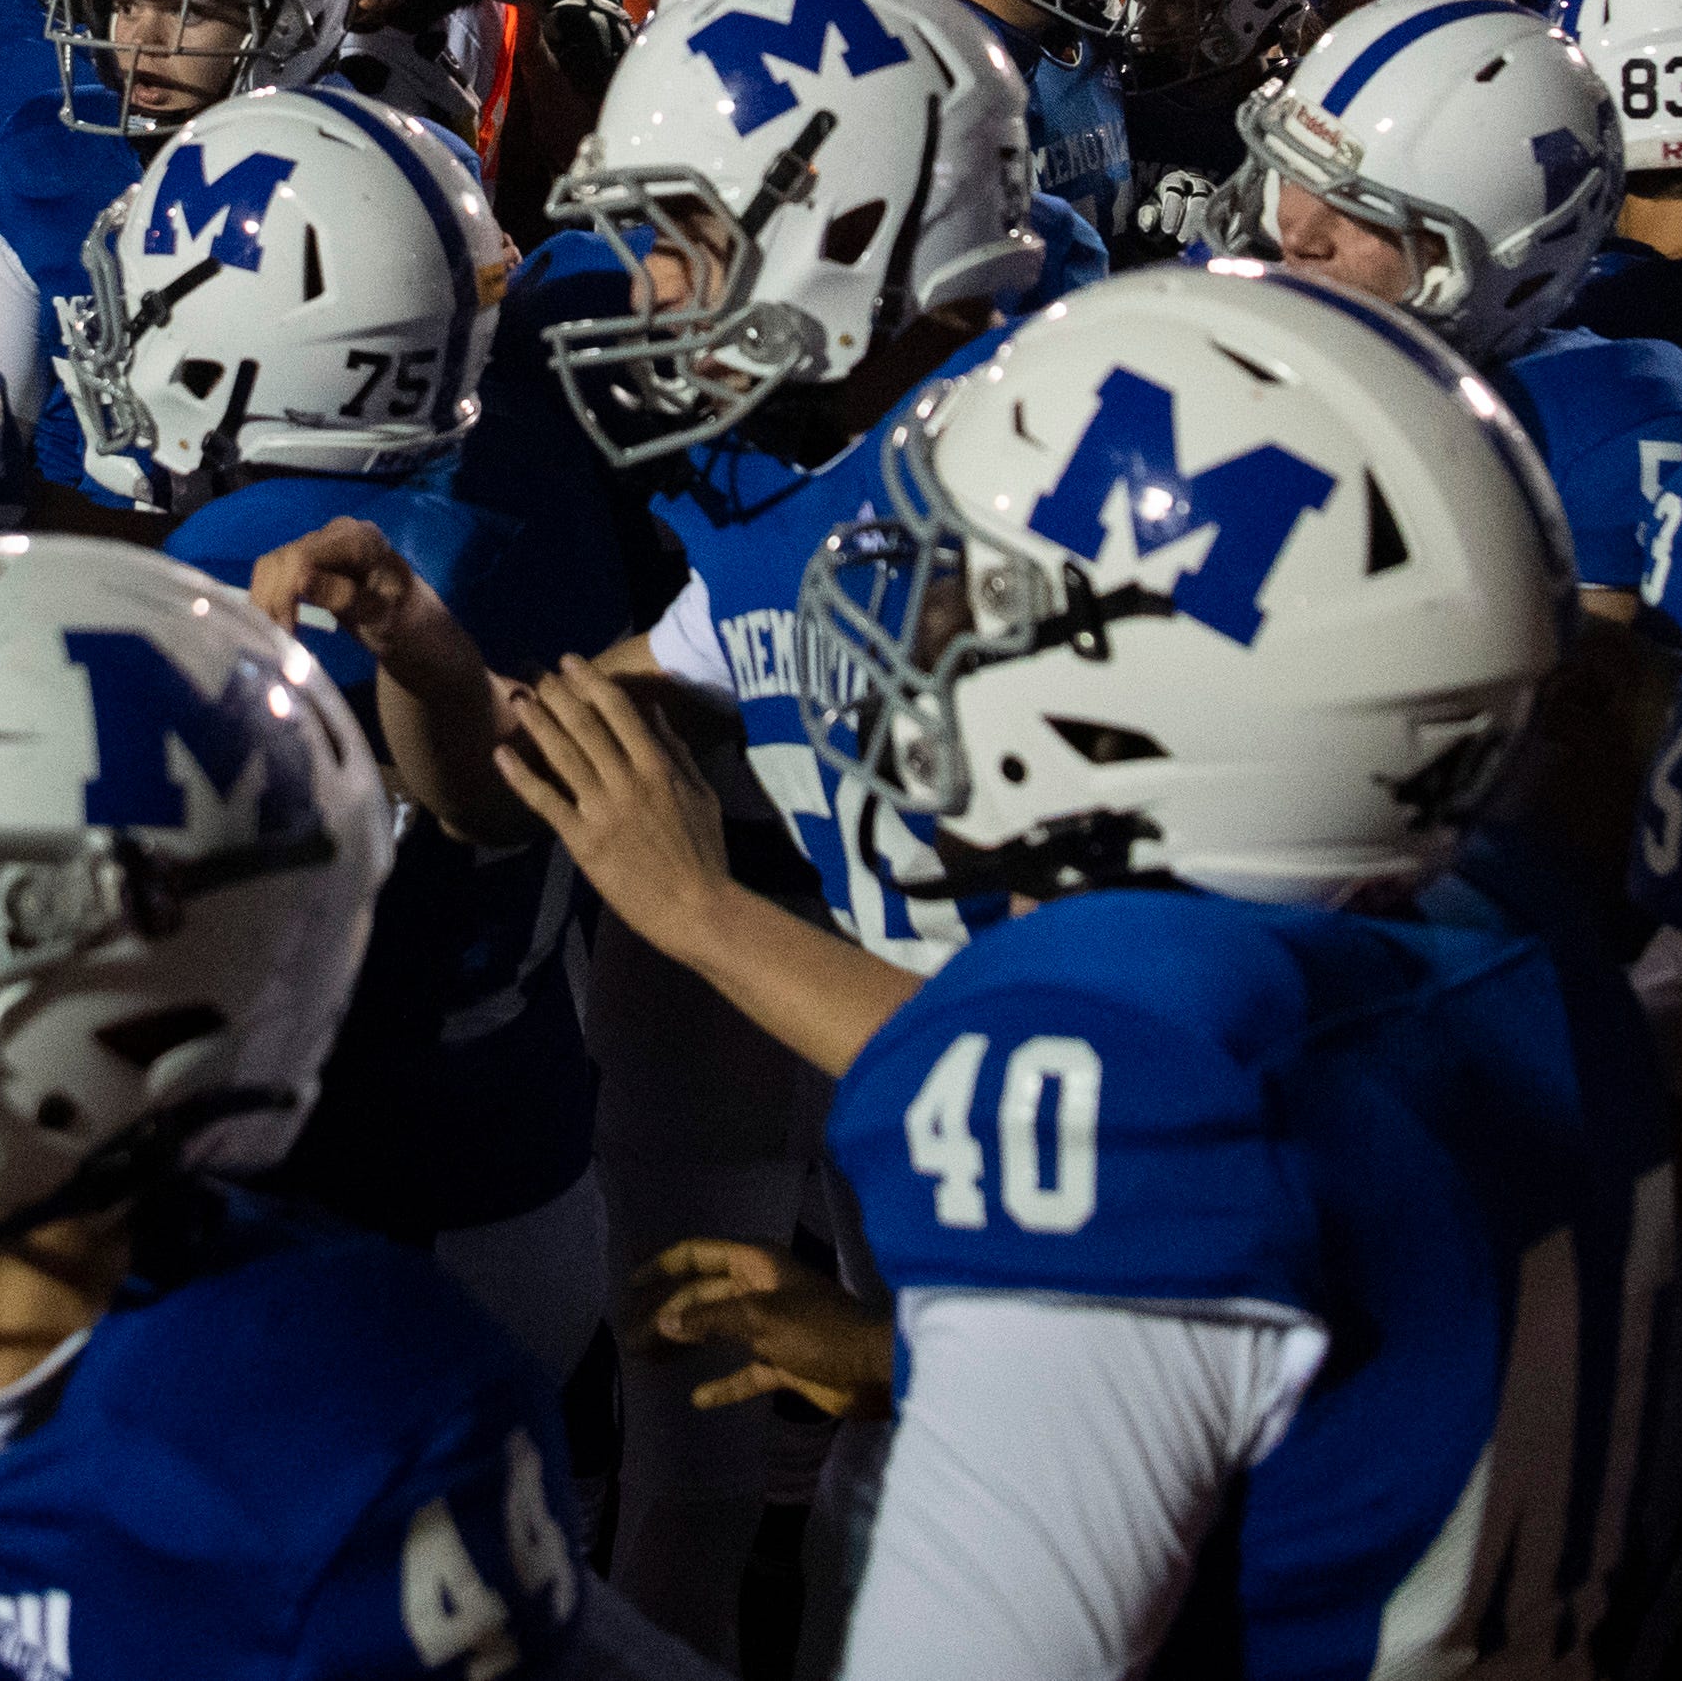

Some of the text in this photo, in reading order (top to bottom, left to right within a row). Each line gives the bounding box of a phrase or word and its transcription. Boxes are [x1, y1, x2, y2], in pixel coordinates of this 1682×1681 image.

[143, 145, 297, 272] M
[342, 348, 440, 419] 75
[1028, 365, 1336, 647] M
[64, 630, 324, 835] M
[903, 1032, 1105, 1236] 40
